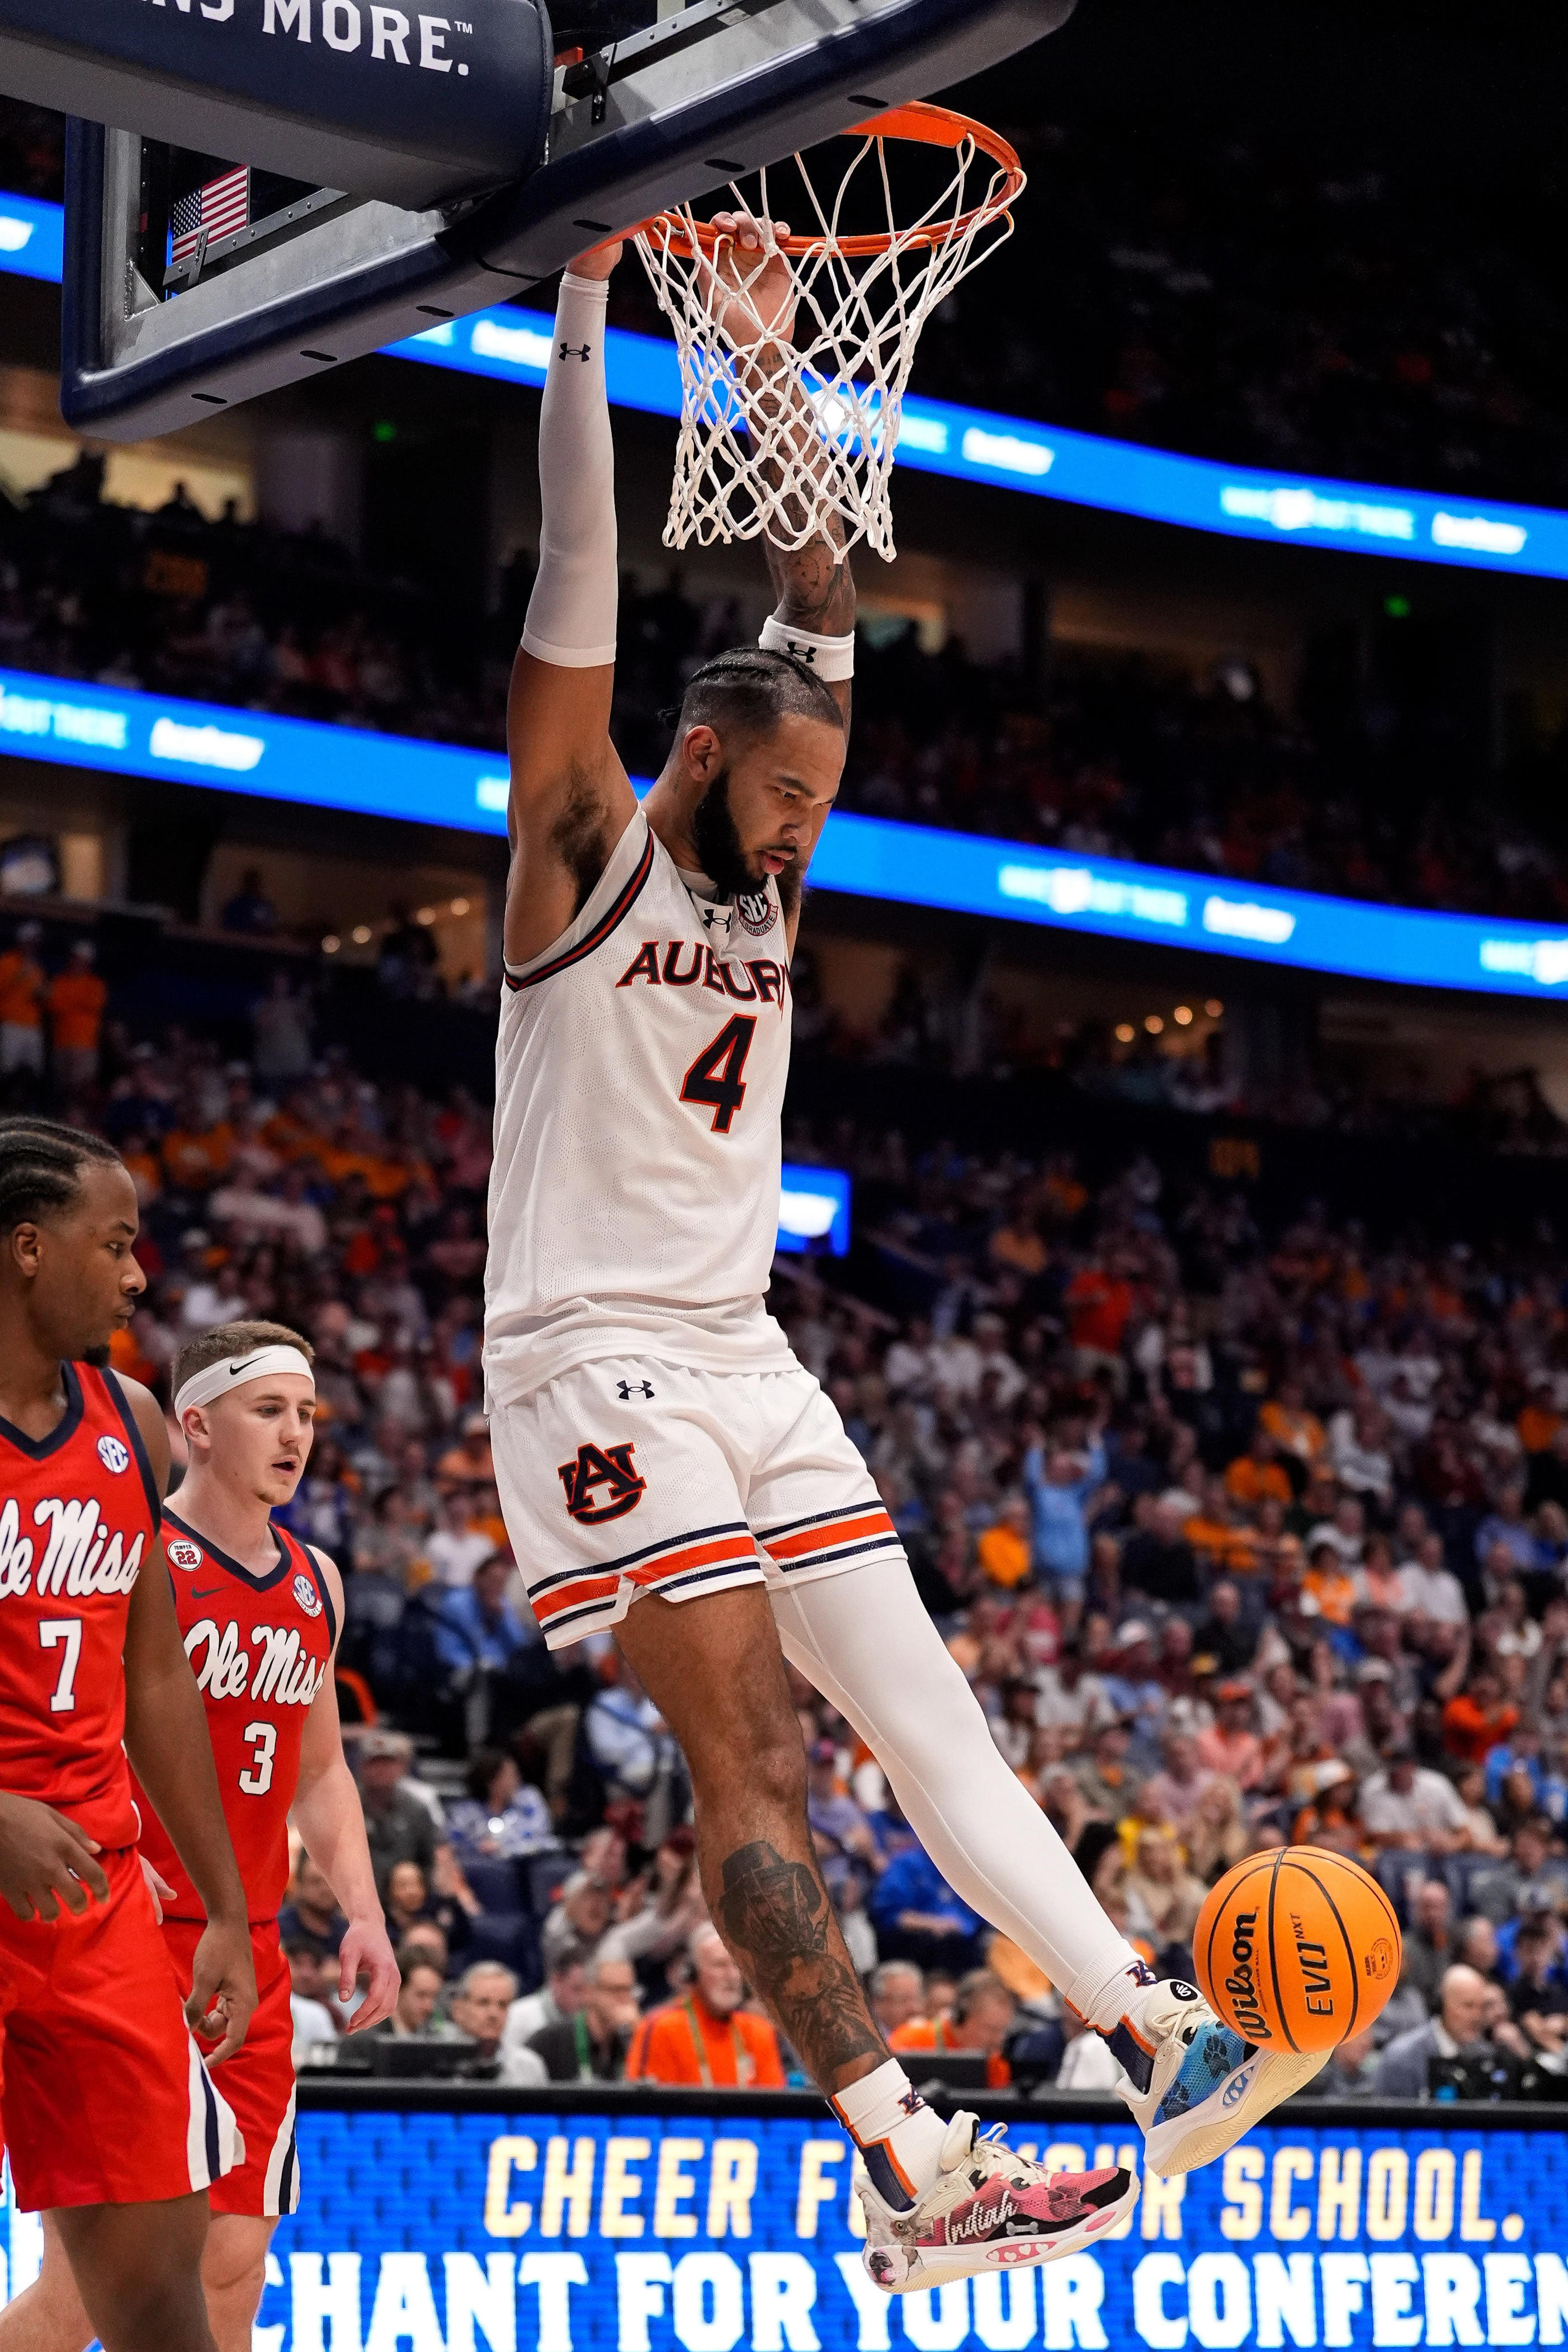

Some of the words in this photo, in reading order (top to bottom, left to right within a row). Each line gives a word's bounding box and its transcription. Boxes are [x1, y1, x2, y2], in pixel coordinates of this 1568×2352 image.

[745, 915, 775, 935] GRADUATE
[679, 1013, 757, 1134] 4
[97, 1436, 129, 1473] SEC
[0, 1498, 34, 1600] le
[34, 1498, 145, 1596] Miss
[176, 1551, 197, 1565] 22
[294, 1575, 315, 1606] SEC
[39, 1619, 82, 1712] 7
[183, 1618, 249, 1699] Ole
[239, 1722, 277, 1795] 3
[1290, 1912, 1305, 1939] NXT
[1225, 1912, 1273, 2039] Wilson
[484, 2135, 758, 2239] CHEER
[1221, 2147, 1525, 2242] SCHOOL.
[617, 2251, 820, 2352] FOR
[834, 2251, 1110, 2352] YOUR
